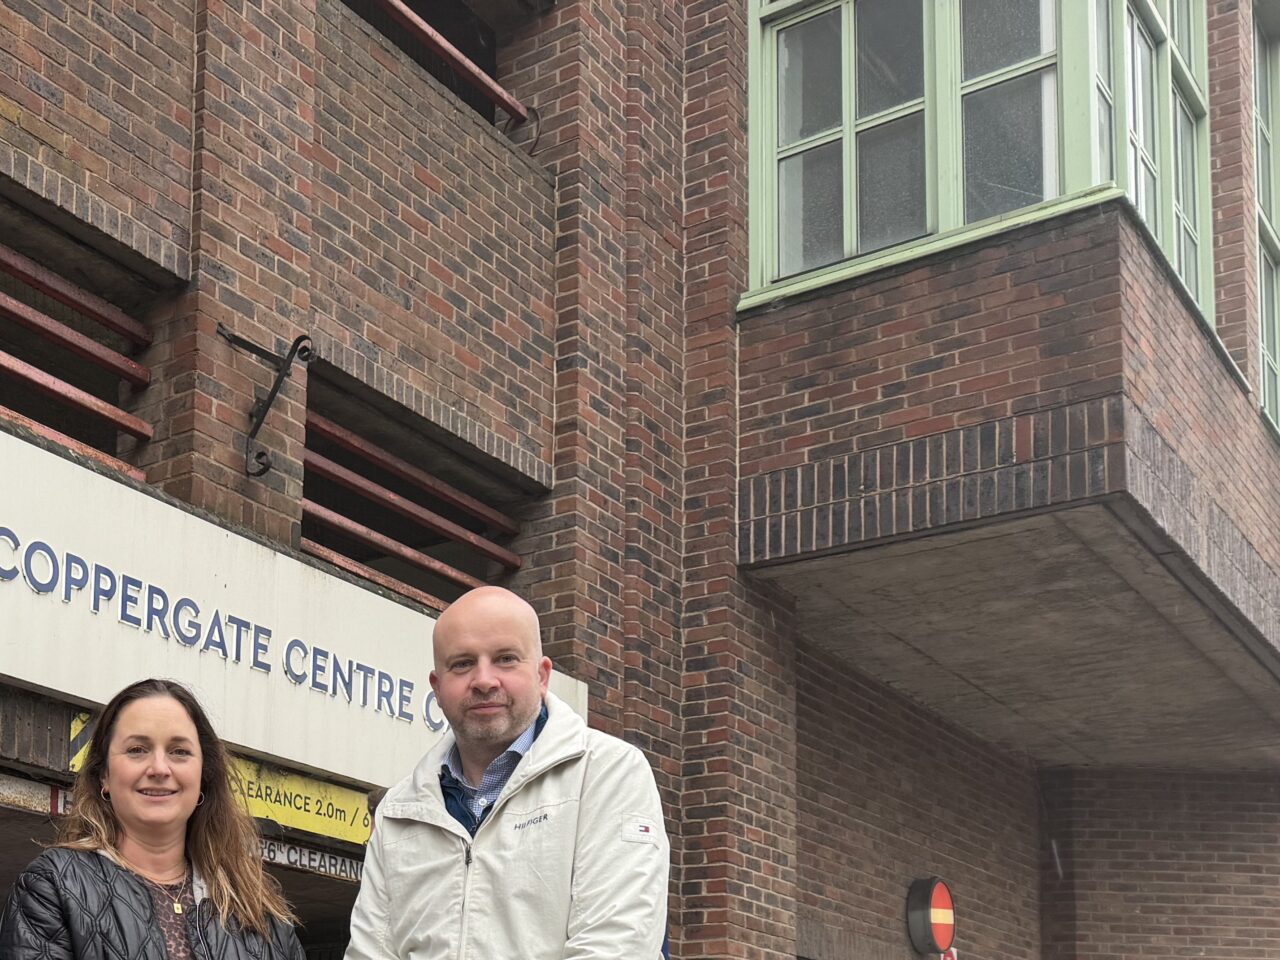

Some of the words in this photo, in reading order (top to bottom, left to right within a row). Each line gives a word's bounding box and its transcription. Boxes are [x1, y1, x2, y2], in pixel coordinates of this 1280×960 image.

[283, 639, 414, 723] CENTRE
[315, 799, 346, 822] 2.0m
[287, 846, 363, 879] CLEARAN
